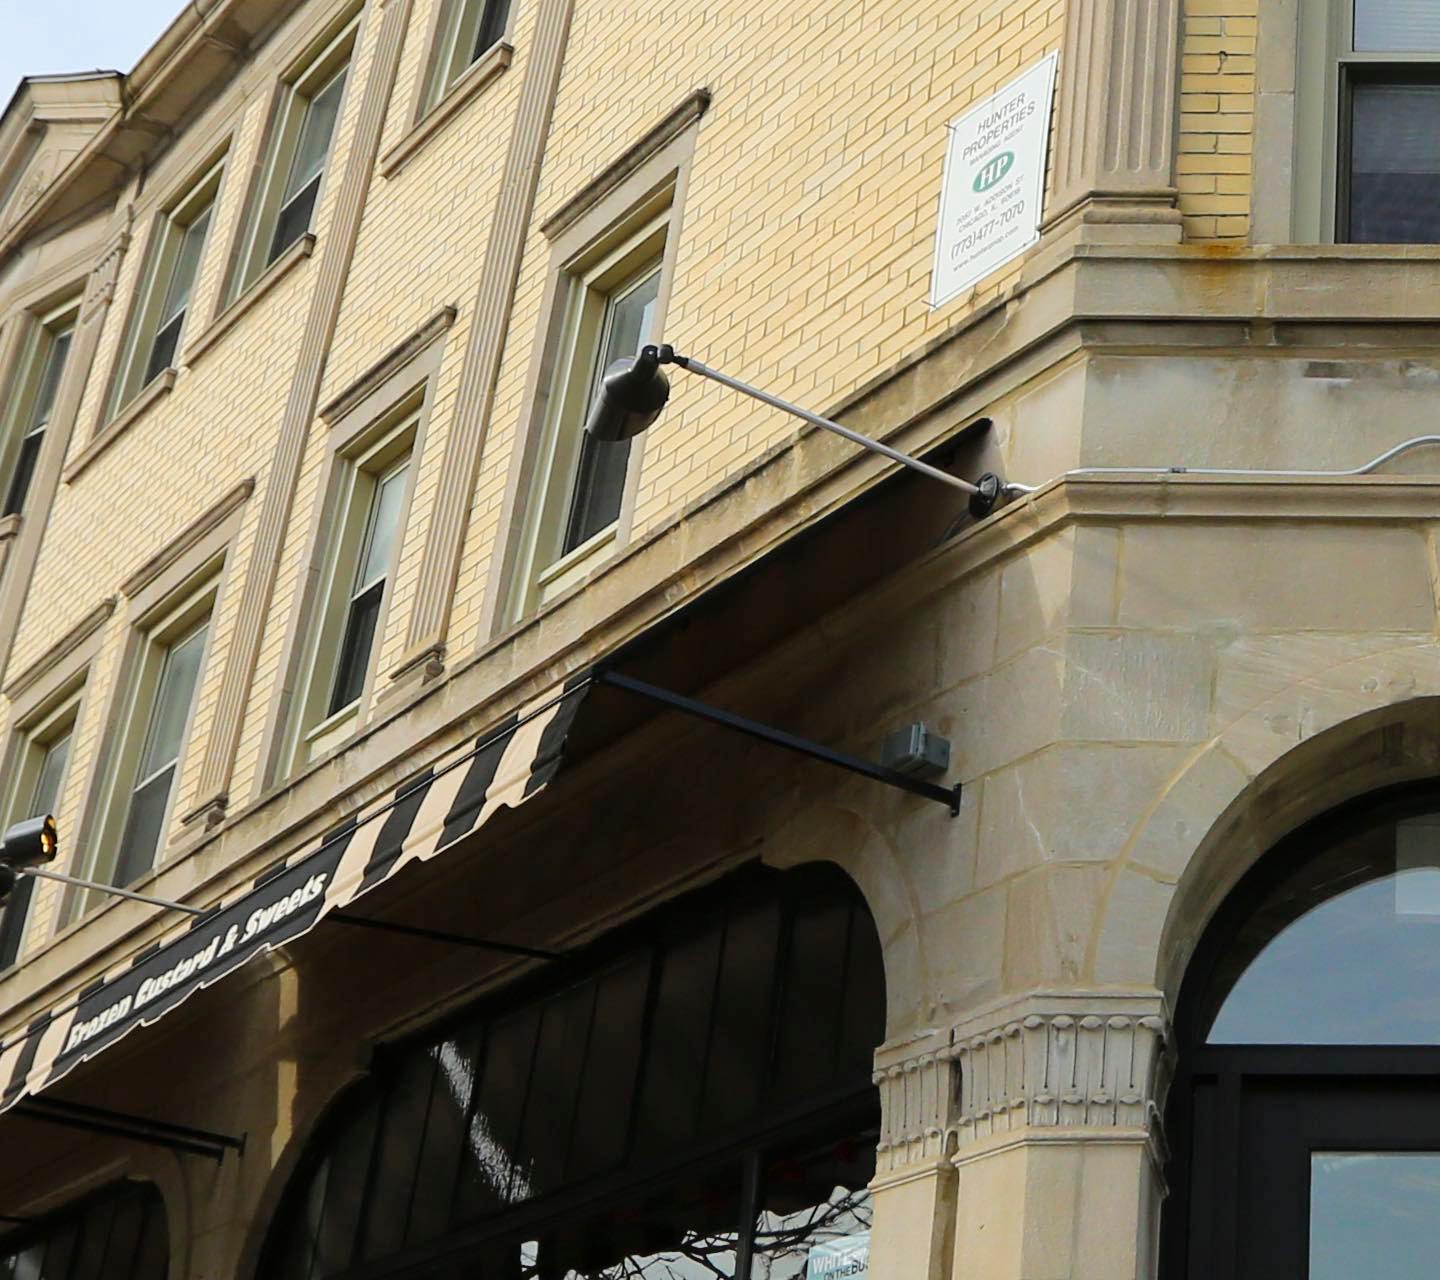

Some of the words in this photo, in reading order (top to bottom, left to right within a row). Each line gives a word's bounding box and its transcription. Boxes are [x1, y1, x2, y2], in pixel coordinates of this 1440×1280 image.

[963, 101, 1035, 160] PROPERTIES
[978, 93, 1025, 134] HUNTER
[979, 154, 1009, 190] HP
[62, 995, 133, 1055] Frozen
[133, 935, 220, 1010] Custard
[217, 924, 242, 958] &
[239, 872, 327, 944] Sweets
